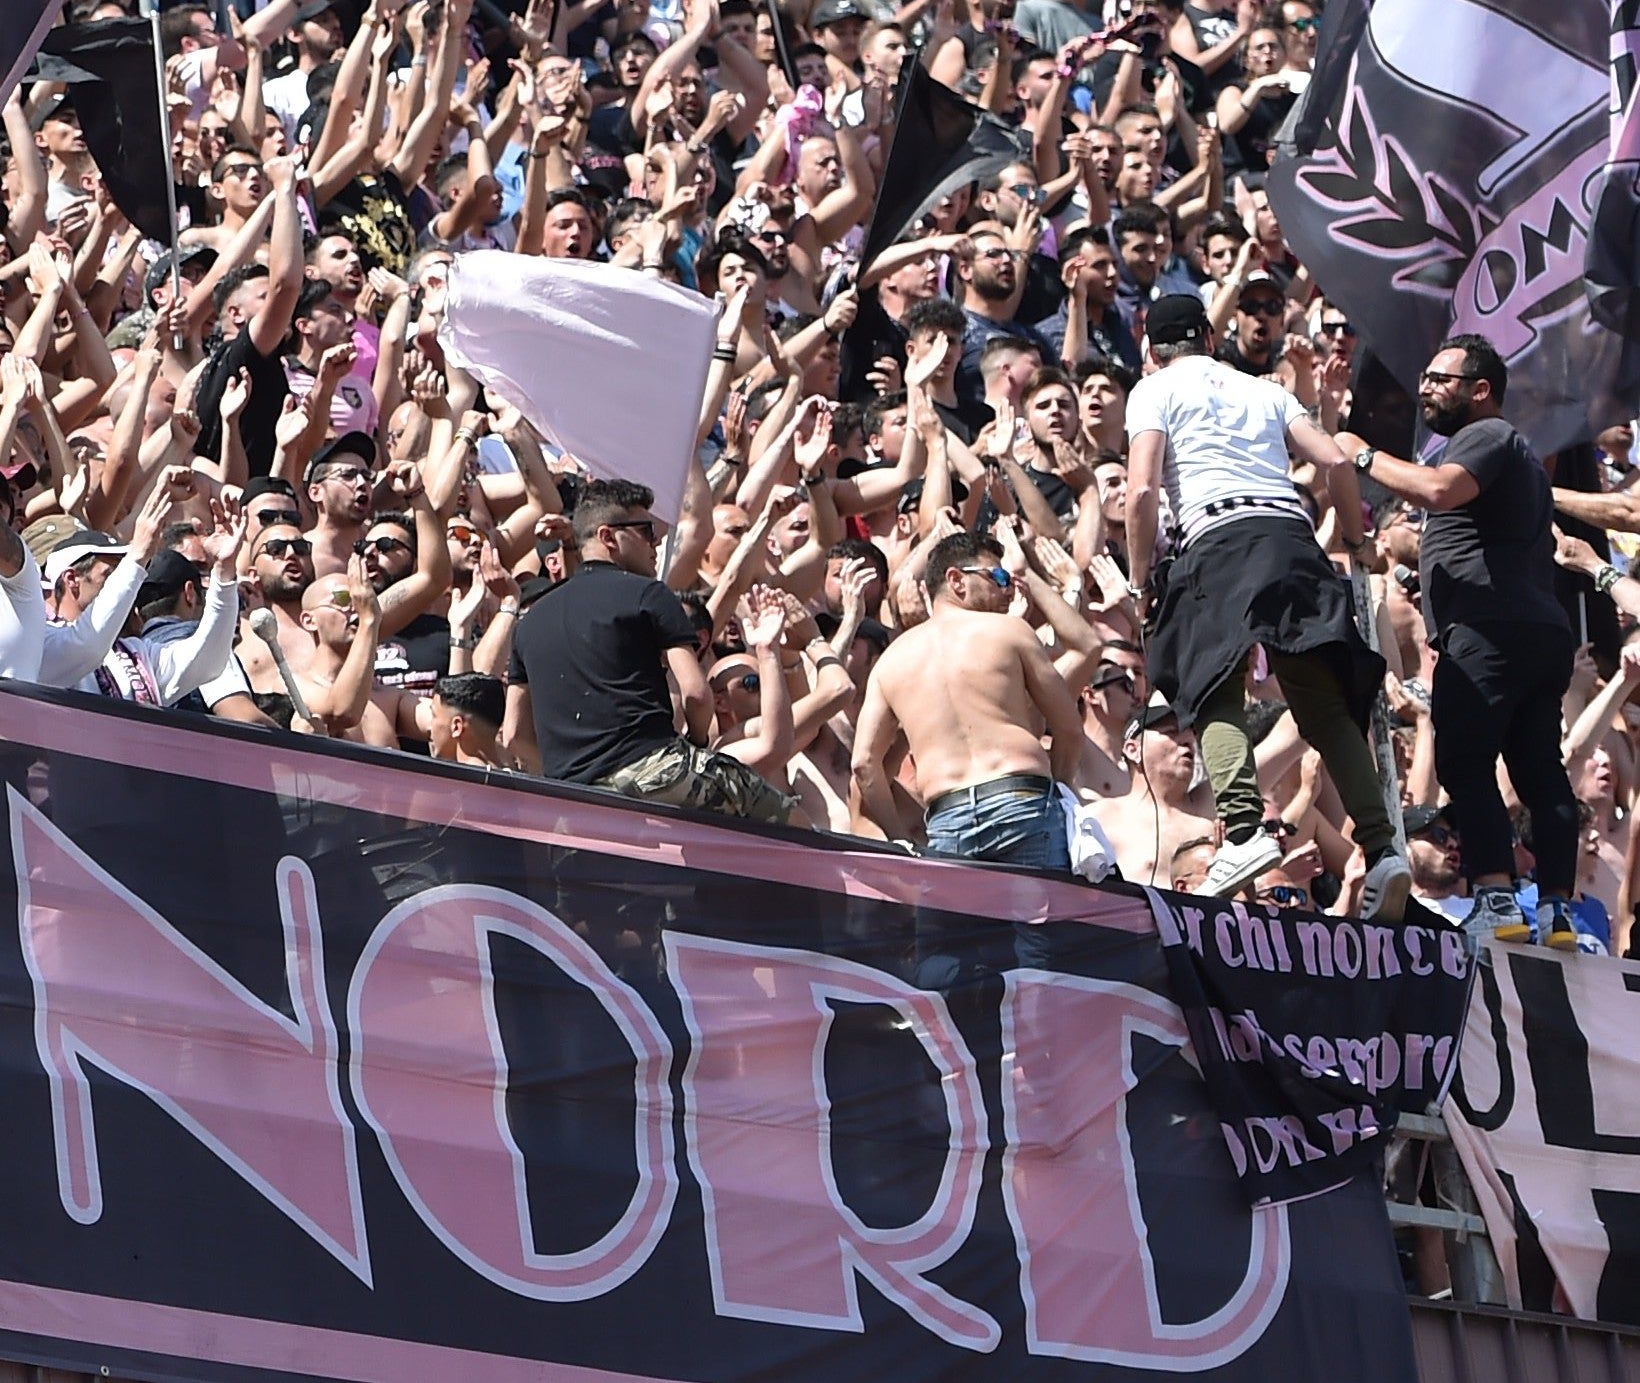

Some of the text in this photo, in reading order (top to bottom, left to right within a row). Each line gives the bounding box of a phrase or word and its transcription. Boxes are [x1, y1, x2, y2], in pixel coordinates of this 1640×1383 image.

[5, 780, 1294, 1374] NORD
[1214, 902, 1292, 973] chi
[1296, 920, 1402, 980] non
